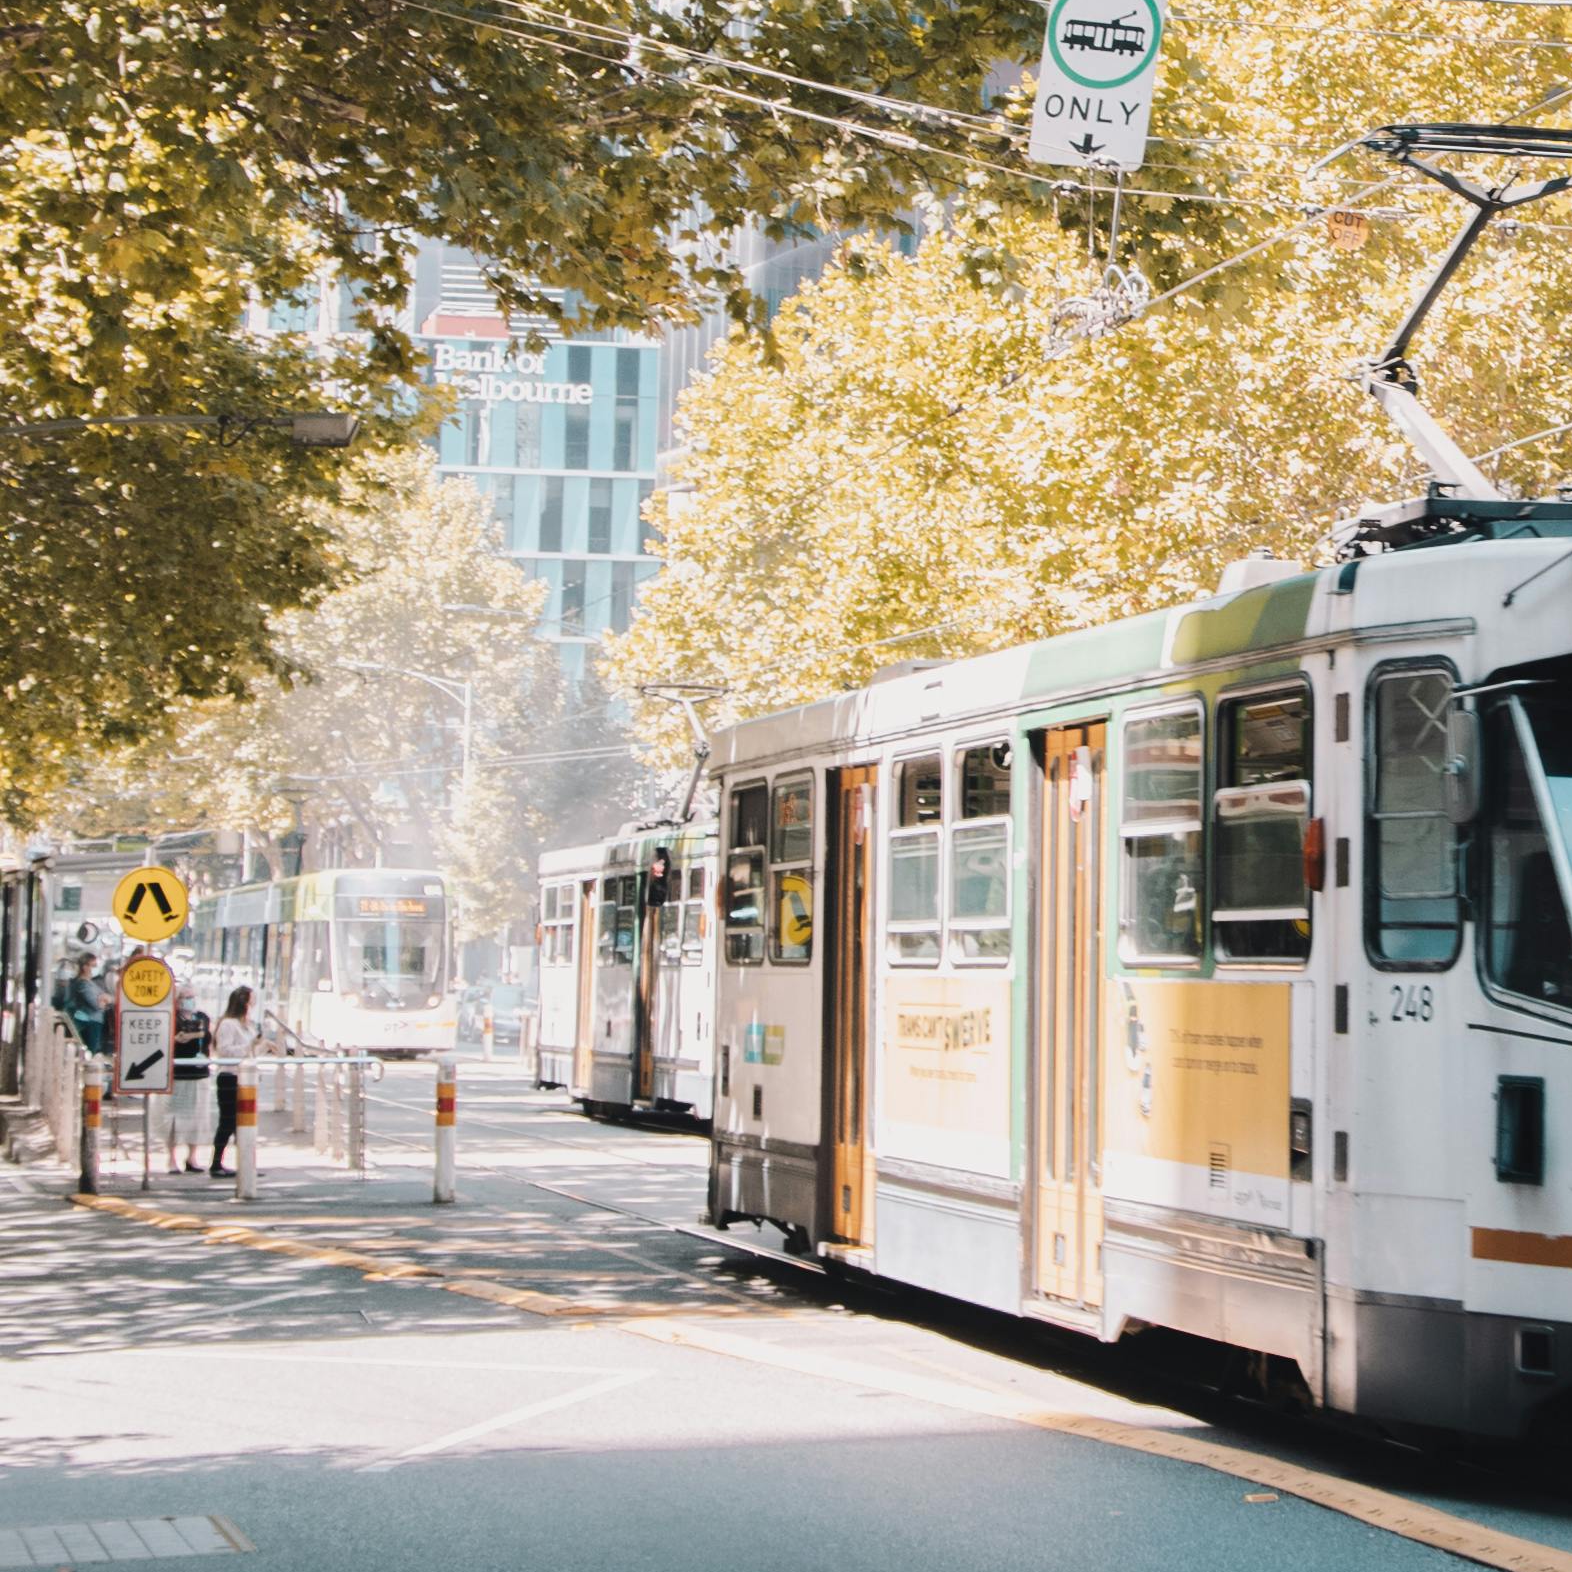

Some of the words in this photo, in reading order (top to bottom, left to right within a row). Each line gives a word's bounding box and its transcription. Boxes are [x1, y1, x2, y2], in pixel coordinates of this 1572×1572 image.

[1045, 94, 1140, 126] ONLY
[433, 343, 513, 374] Bank
[516, 349, 549, 375] of
[128, 969, 166, 983] SAFETY
[134, 985, 159, 998] ZONE
[1390, 984, 1434, 1023] 248
[128, 1018, 162, 1031] KEEP
[129, 1033, 161, 1045] LEFT
